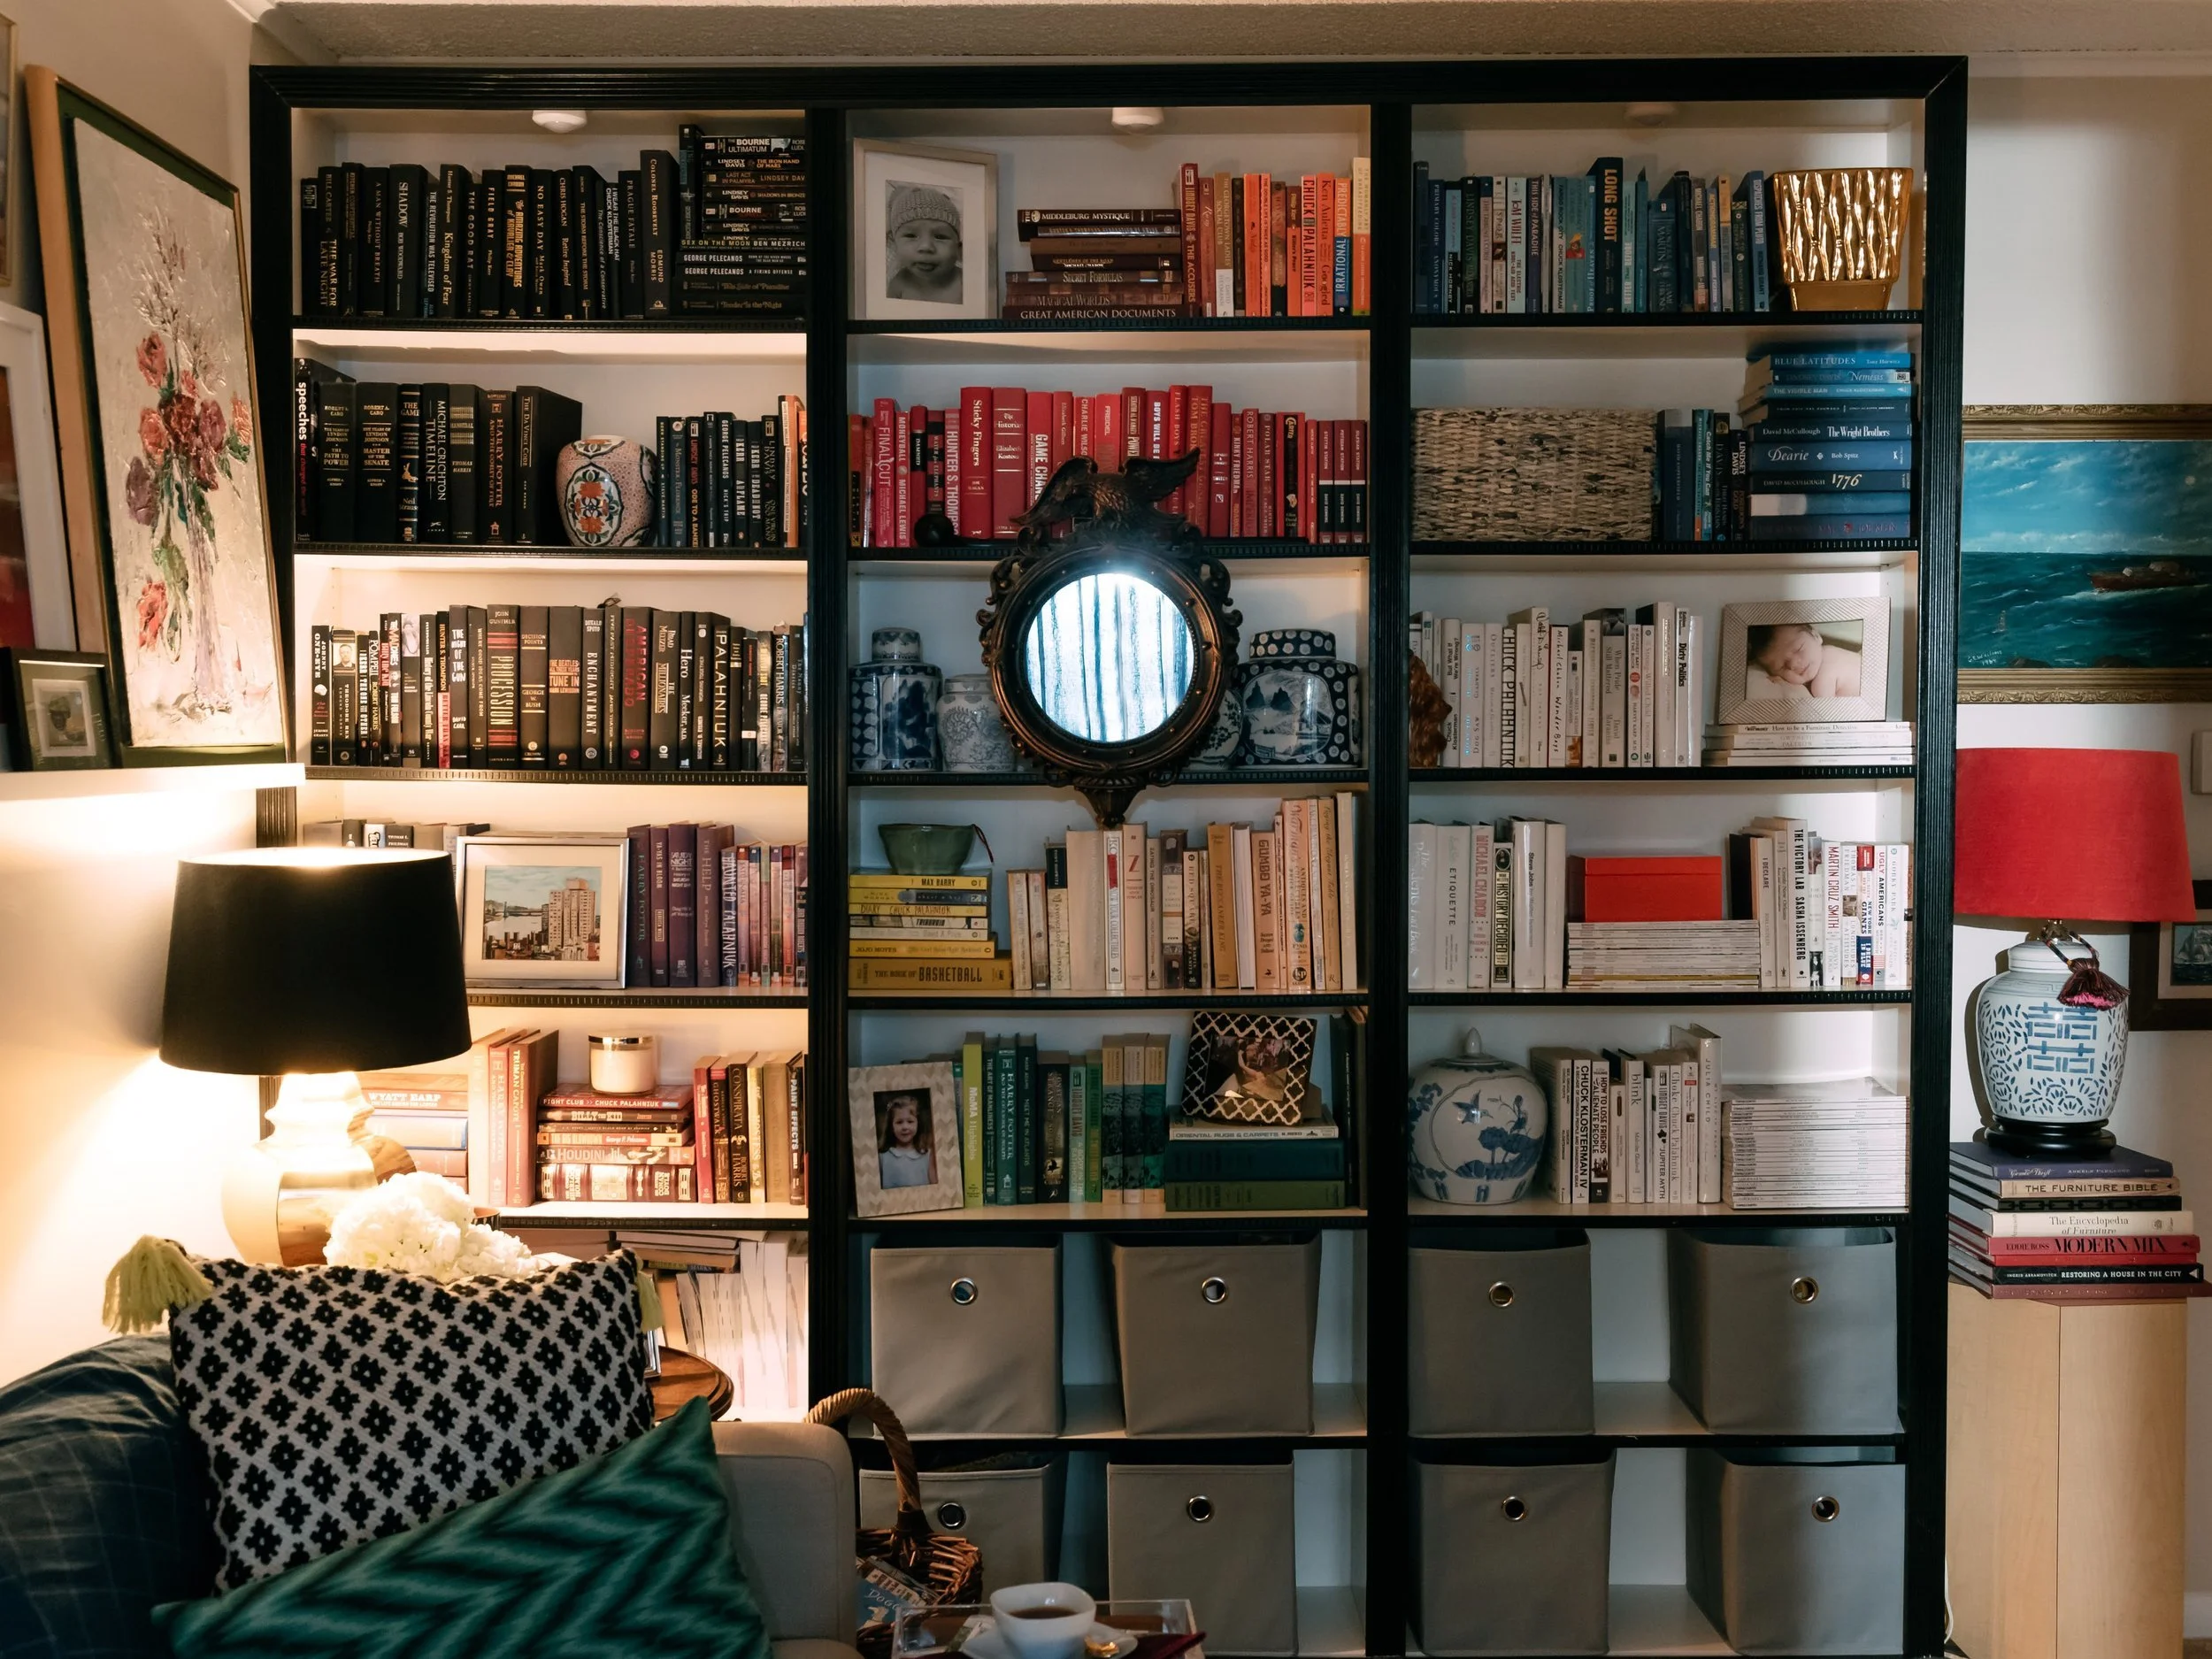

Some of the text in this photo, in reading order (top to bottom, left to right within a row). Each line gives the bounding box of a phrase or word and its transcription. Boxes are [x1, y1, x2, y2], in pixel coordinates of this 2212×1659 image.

[397, 182, 409, 228] SHADOW
[537, 186, 545, 199] NO
[1604, 169, 1617, 242] LONG SHOT
[319, 241, 328, 267] LATE
[1303, 180, 1315, 288] CHUCK PALAHNIUK
[1320, 180, 1331, 306] Ken Auletta Googled
[1335, 182, 1348, 292] PREDICTABLY IRRATIONAL
[329, 262, 338, 284] WAR
[442, 233, 453, 305] Kingdom of Fear
[1055, 310, 1108, 319] AMERICAN
[1111, 309, 1176, 318] DOCUMENTS
[296, 382, 310, 441] speeches
[971, 400, 982, 466] Sticky Fingers
[1827, 426, 1839, 437] The
[1839, 426, 1862, 438] Wright
[1863, 426, 1890, 437] Brothers
[426, 419, 435, 482] TIMELINE
[437, 400, 446, 501] MICHAEL CRICHTON
[879, 427, 891, 486] FINAL CUT
[1035, 434, 1048, 463] GAME
[1706, 452, 1712, 462] Me
[1768, 446, 1809, 462] Dearie
[1832, 473, 1863, 489] 1776
[370, 640, 379, 676] POMPEII
[680, 649, 692, 678] Hero
[1678, 642, 1686, 660] Dirty
[490, 656, 514, 726] PROCESSION
[586, 652, 597, 734] ENCHANTMENT
[714, 634, 726, 747] PALAHNIUK
[1502, 628, 1515, 766] CHUCK PALAHNIUK
[702, 857, 711, 891] HELP
[1258, 840, 1271, 916] GUMBO YA-YA
[1794, 829, 1805, 960] THE VICTORY LAB SASHA ISSENBERG
[1828, 847, 1839, 928] MARTIN CRUZ SMITH
[723, 856, 737, 968] HAUNTED PALAHNIUK
[1495, 883, 1509, 952] HISTORY DECODED
[919, 967, 982, 981] BASKETBALL
[733, 1069, 742, 1130] CONSPIRATA
[969, 1087, 978, 1118] MoMA
[1632, 1073, 1641, 1106] blink
[733, 1154, 741, 1187] HARRIS
[1579, 1179, 1587, 1188] IV
[2049, 1216, 2129, 1226] The Encyclopedia
[2055, 1238, 2167, 1252] MODERN MIX
